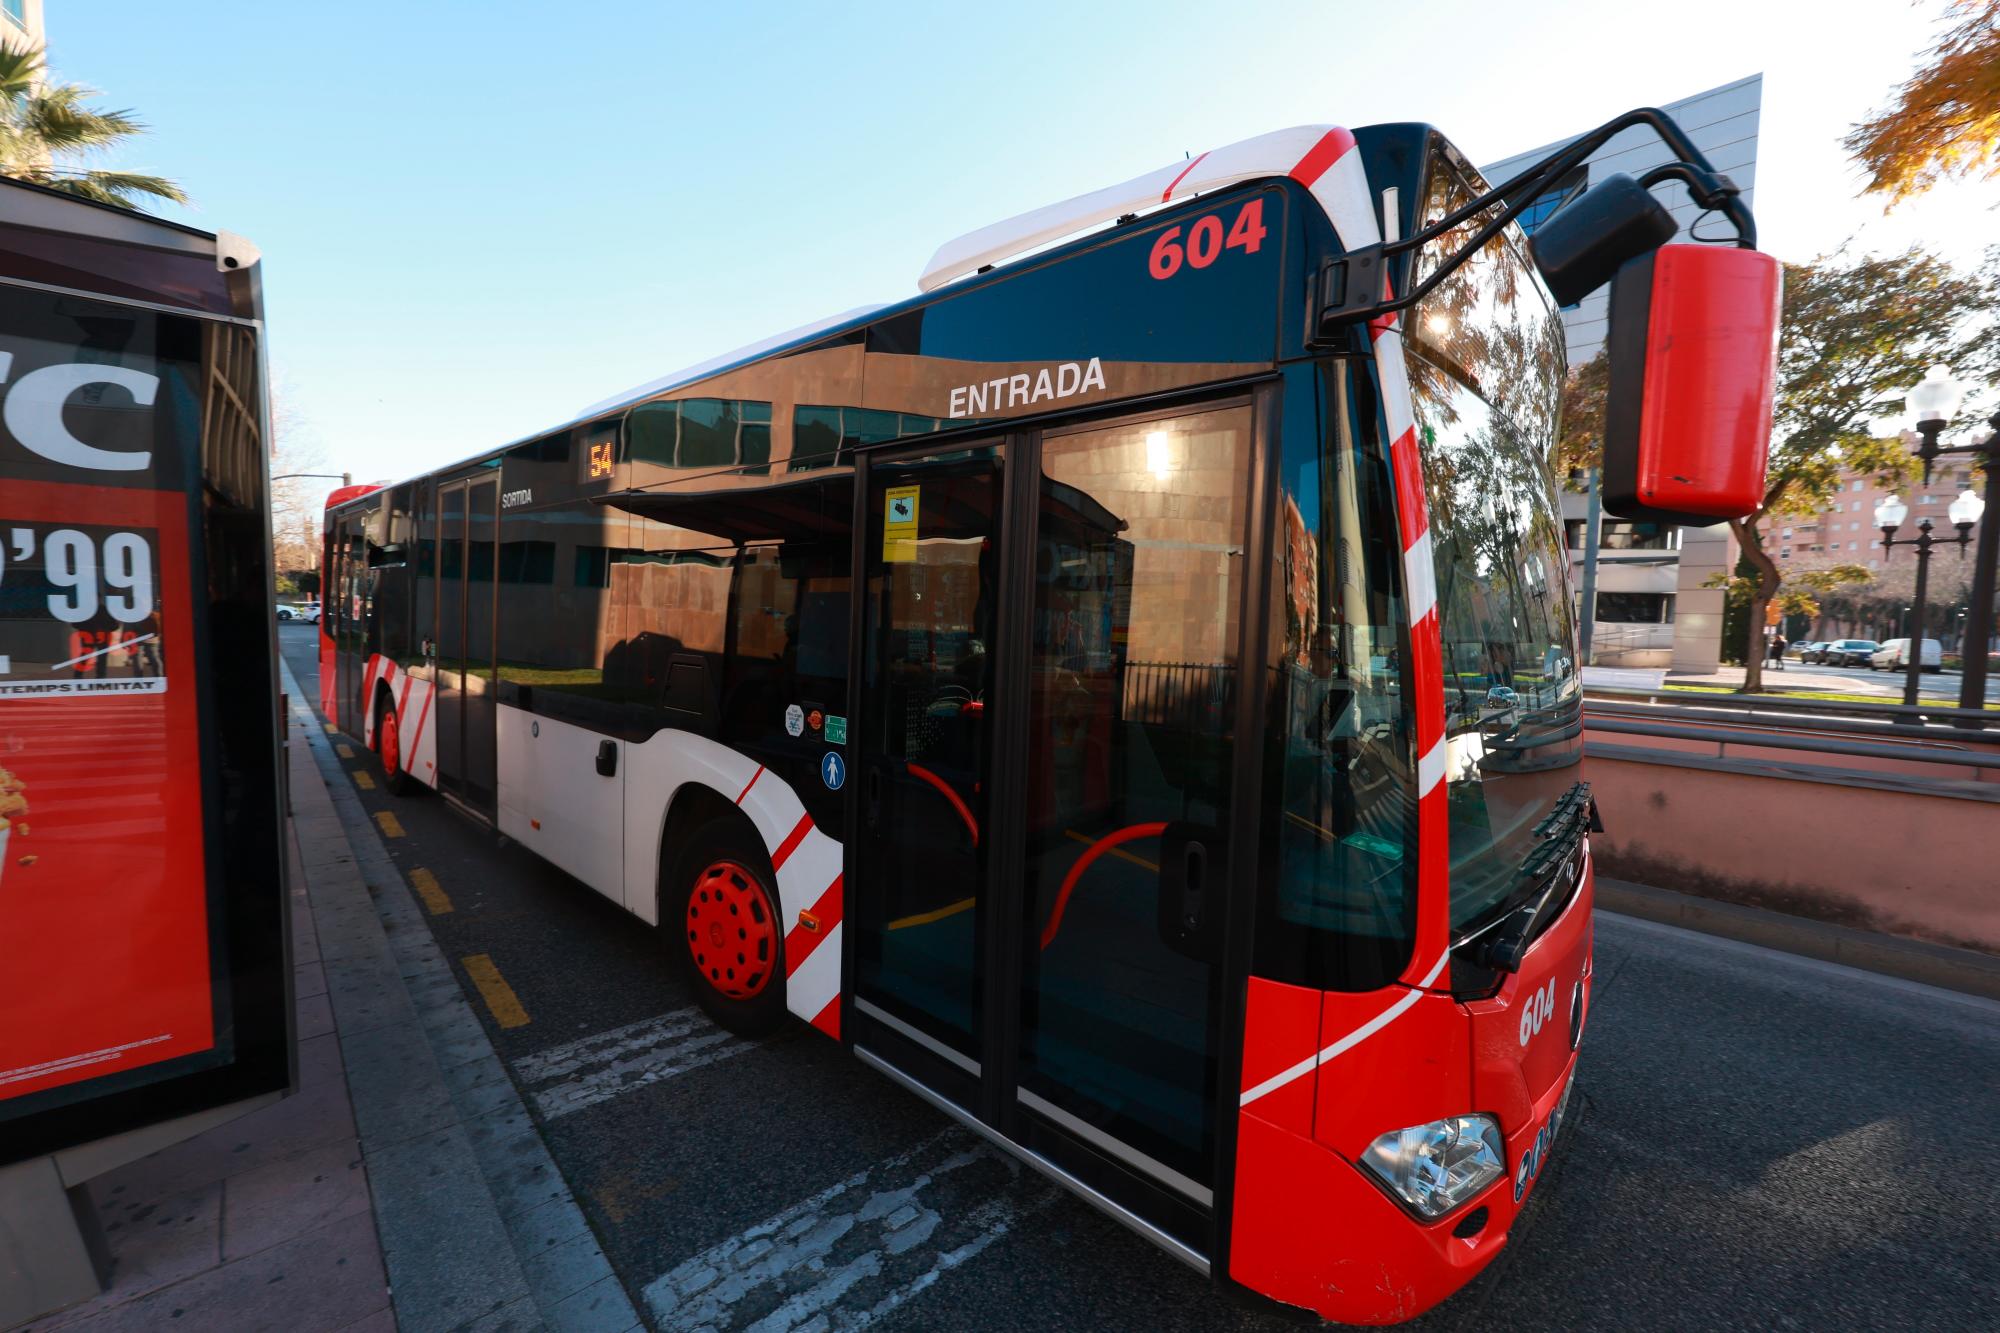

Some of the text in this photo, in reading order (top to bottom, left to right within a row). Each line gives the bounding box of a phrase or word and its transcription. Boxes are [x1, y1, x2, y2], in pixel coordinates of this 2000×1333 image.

[1149, 198, 1267, 280] 604
[0, 351, 160, 471] C
[949, 356, 1106, 419] ENTRADA
[591, 442, 612, 477] 54
[502, 488, 532, 508] SORTIDA
[0, 528, 154, 623] '99
[0, 681, 155, 694] TEMPS LIMITAT
[1519, 975, 1556, 1047] 604
